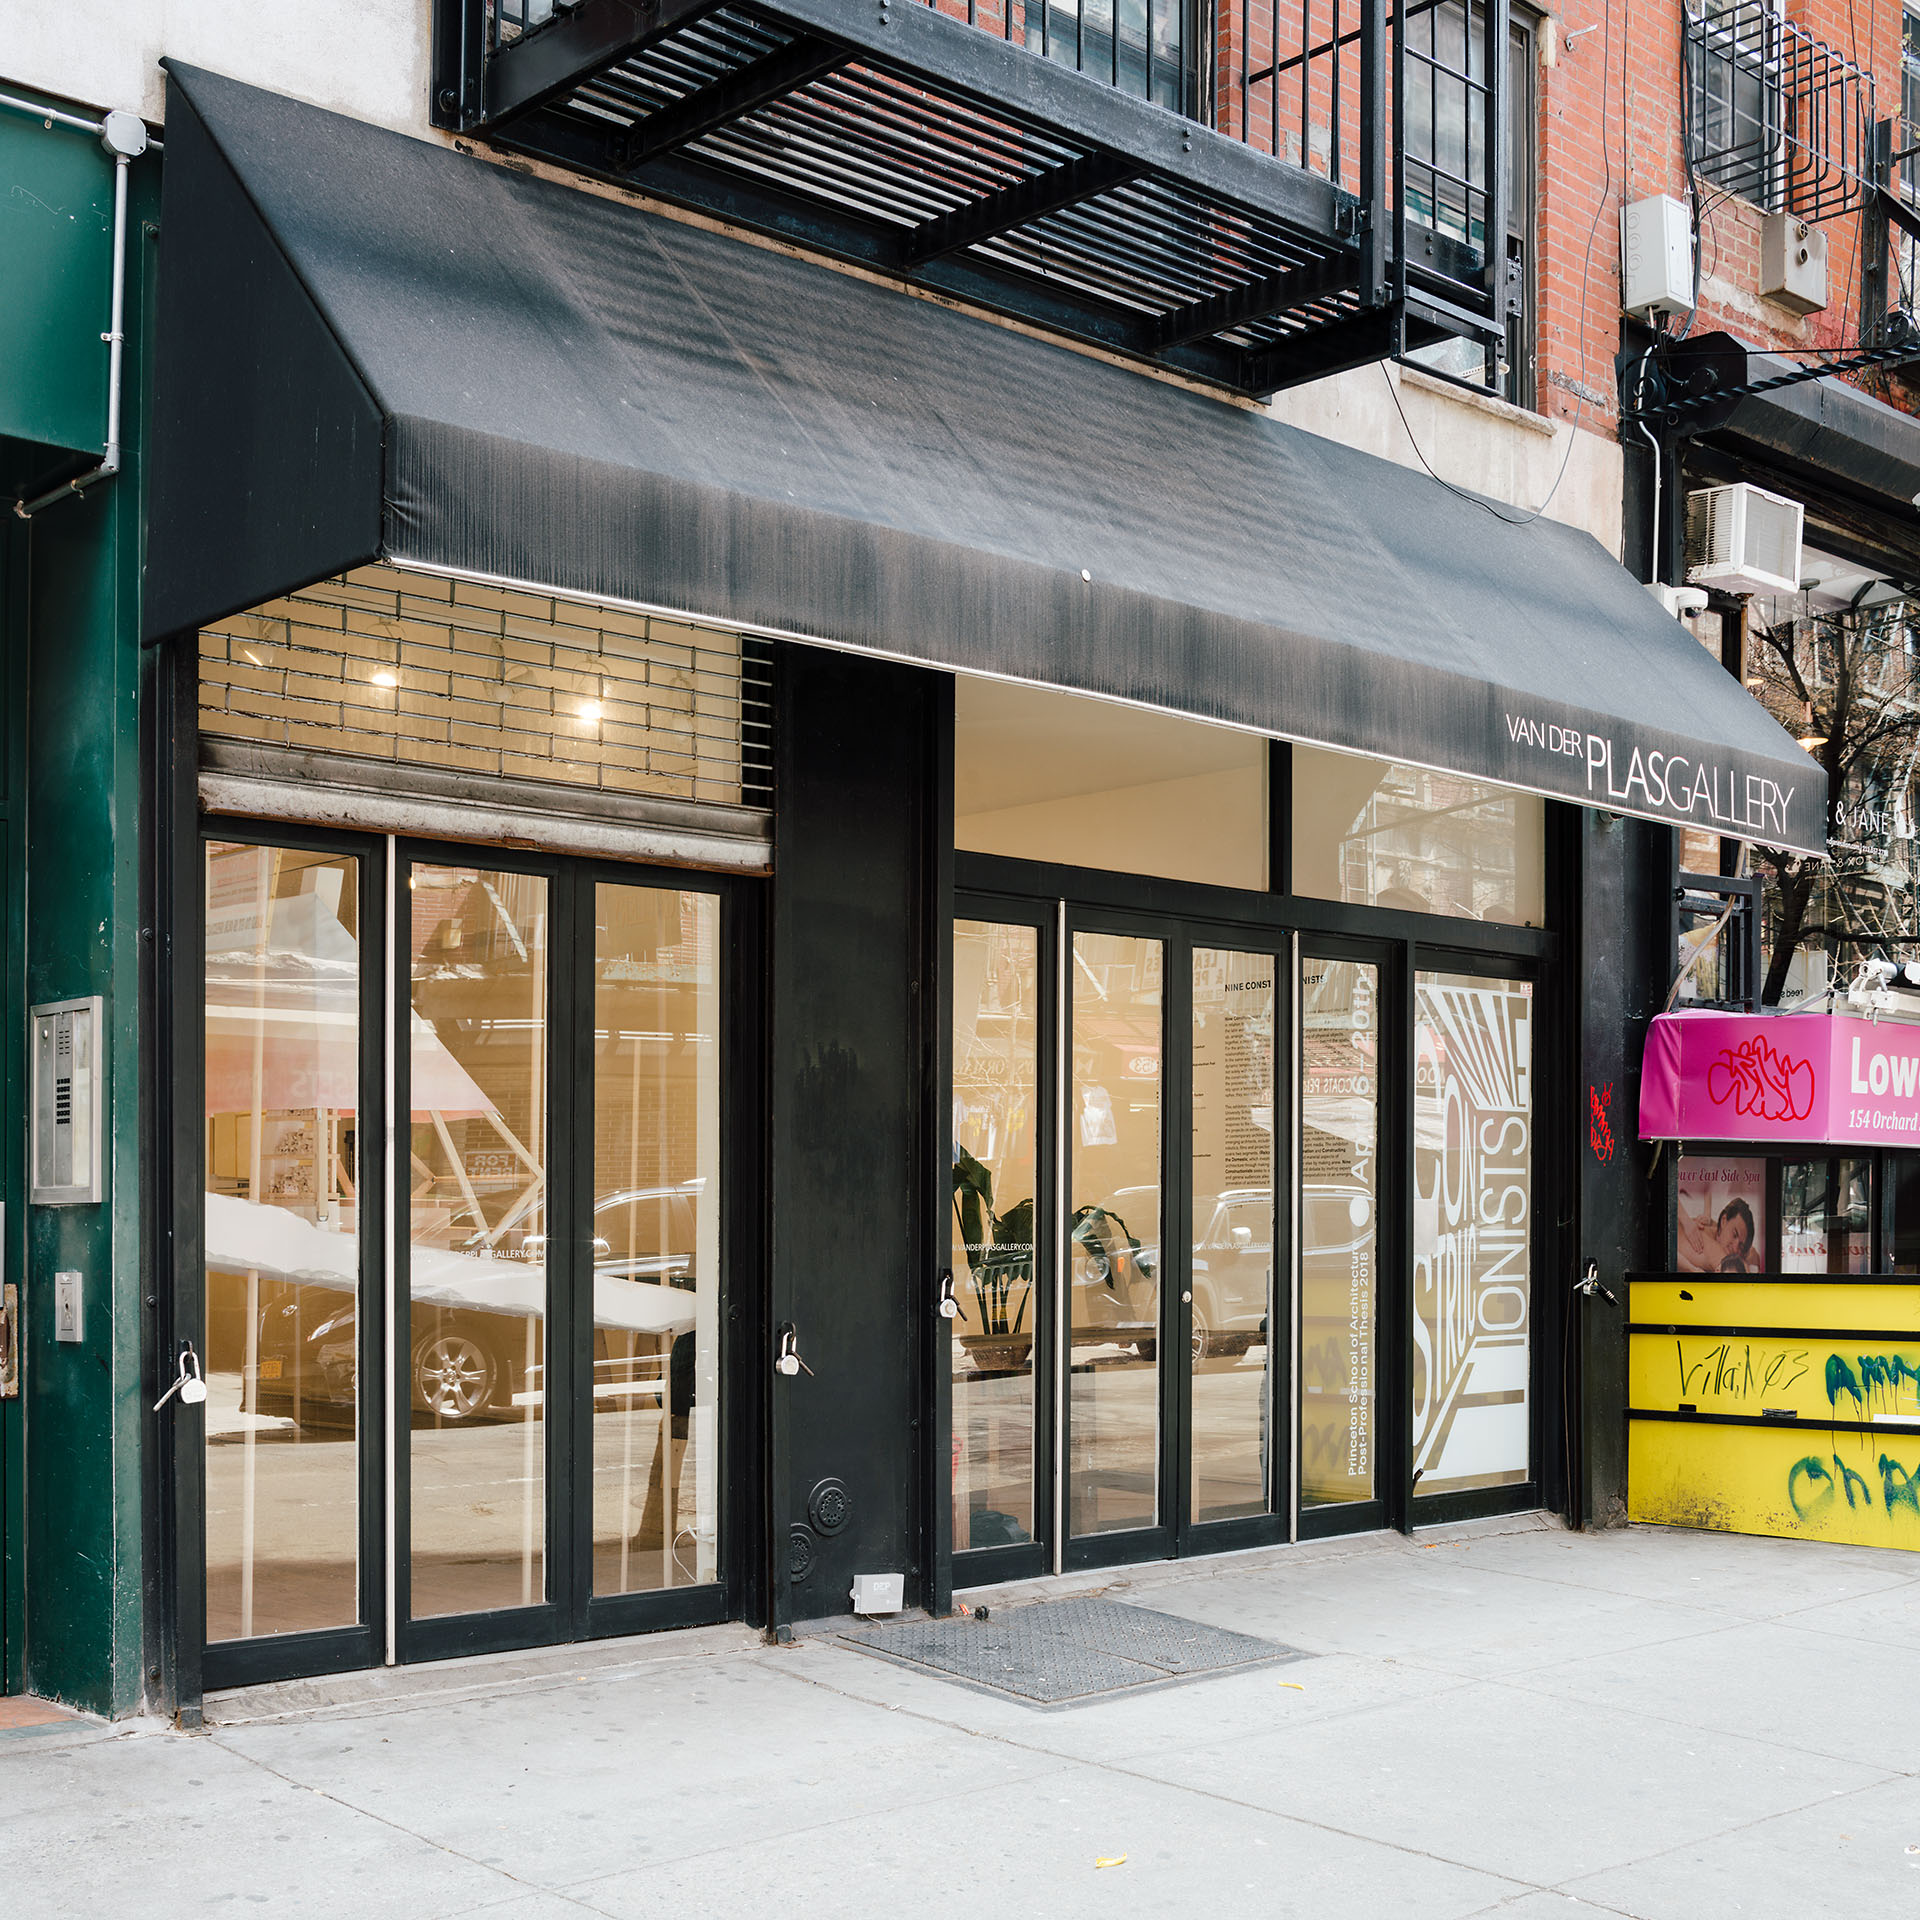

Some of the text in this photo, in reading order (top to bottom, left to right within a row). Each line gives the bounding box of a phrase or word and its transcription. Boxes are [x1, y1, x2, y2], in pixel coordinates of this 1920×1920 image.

[1506, 713, 1545, 749] VAN
[1549, 724, 1583, 759] DER
[1835, 800, 1890, 836] & JANE
[1224, 982, 1244, 992] NINE
[1851, 1036, 1920, 1098] Low
[1848, 1109, 1918, 1132] 154 Orchard
[1699, 1168, 1718, 1182] East
[1721, 1168, 1740, 1182] Side
[1743, 1169, 1761, 1185] Spa
[1350, 1334, 1359, 1348] of
[1349, 1351, 1358, 1403] School
[1358, 1252, 1369, 1475] Post-Professional Thesis 2018
[1348, 1407, 1358, 1476] Princeton
